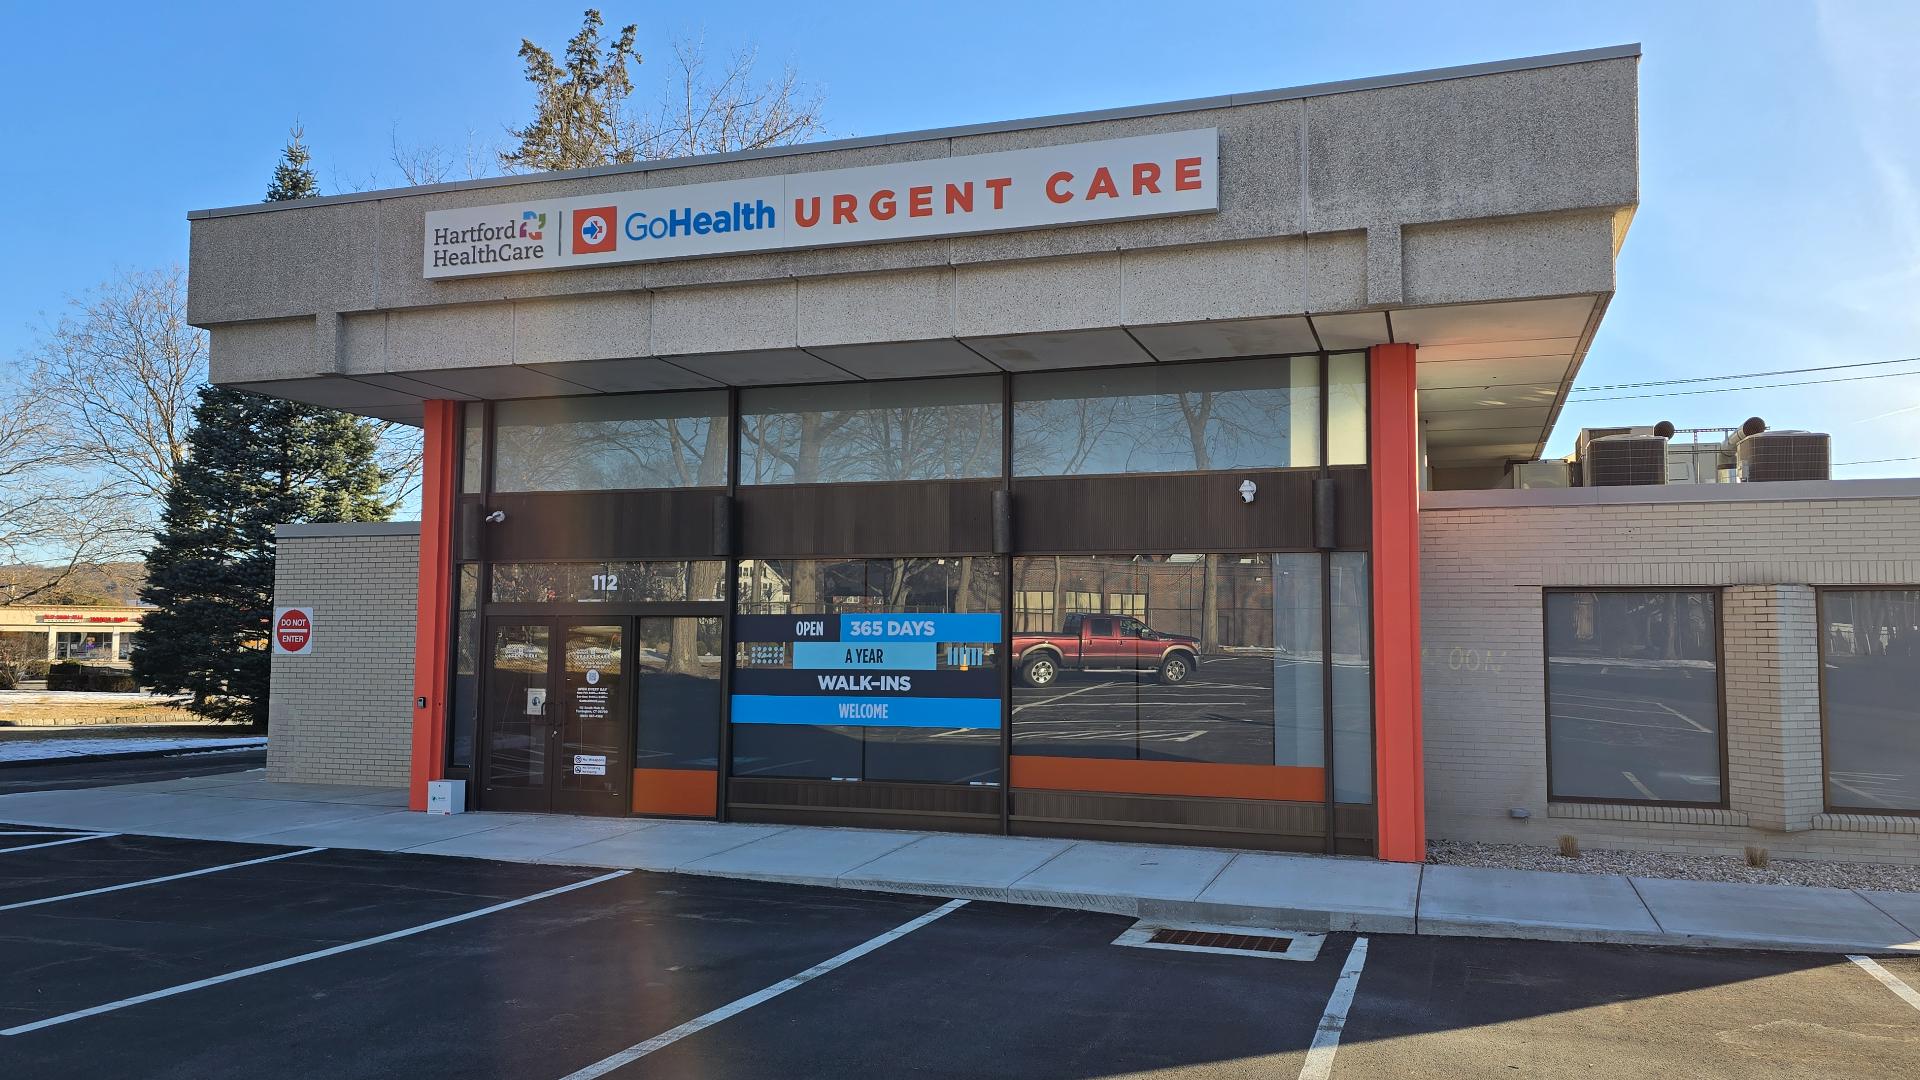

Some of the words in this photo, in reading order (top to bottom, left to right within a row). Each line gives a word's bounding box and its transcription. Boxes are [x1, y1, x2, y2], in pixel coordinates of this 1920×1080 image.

[794, 177, 1012, 228] URGENT
[1045, 157, 1202, 204] CARE
[625, 199, 775, 241] GoHealth
[433, 220, 517, 246] Hartford
[432, 242, 544, 268] HealthCare
[591, 574, 618, 591] 112
[281, 618, 291, 627] DO
[292, 618, 306, 627] NOT
[795, 621, 824, 637] OPEN
[850, 620, 882, 637] 365
[887, 620, 935, 637] DAYS
[282, 635, 304, 643] ENTER
[845, 648, 853, 664] A
[856, 648, 884, 664] YEAR
[817, 675, 912, 691] WALK-INS
[838, 703, 889, 719] WELCOME
